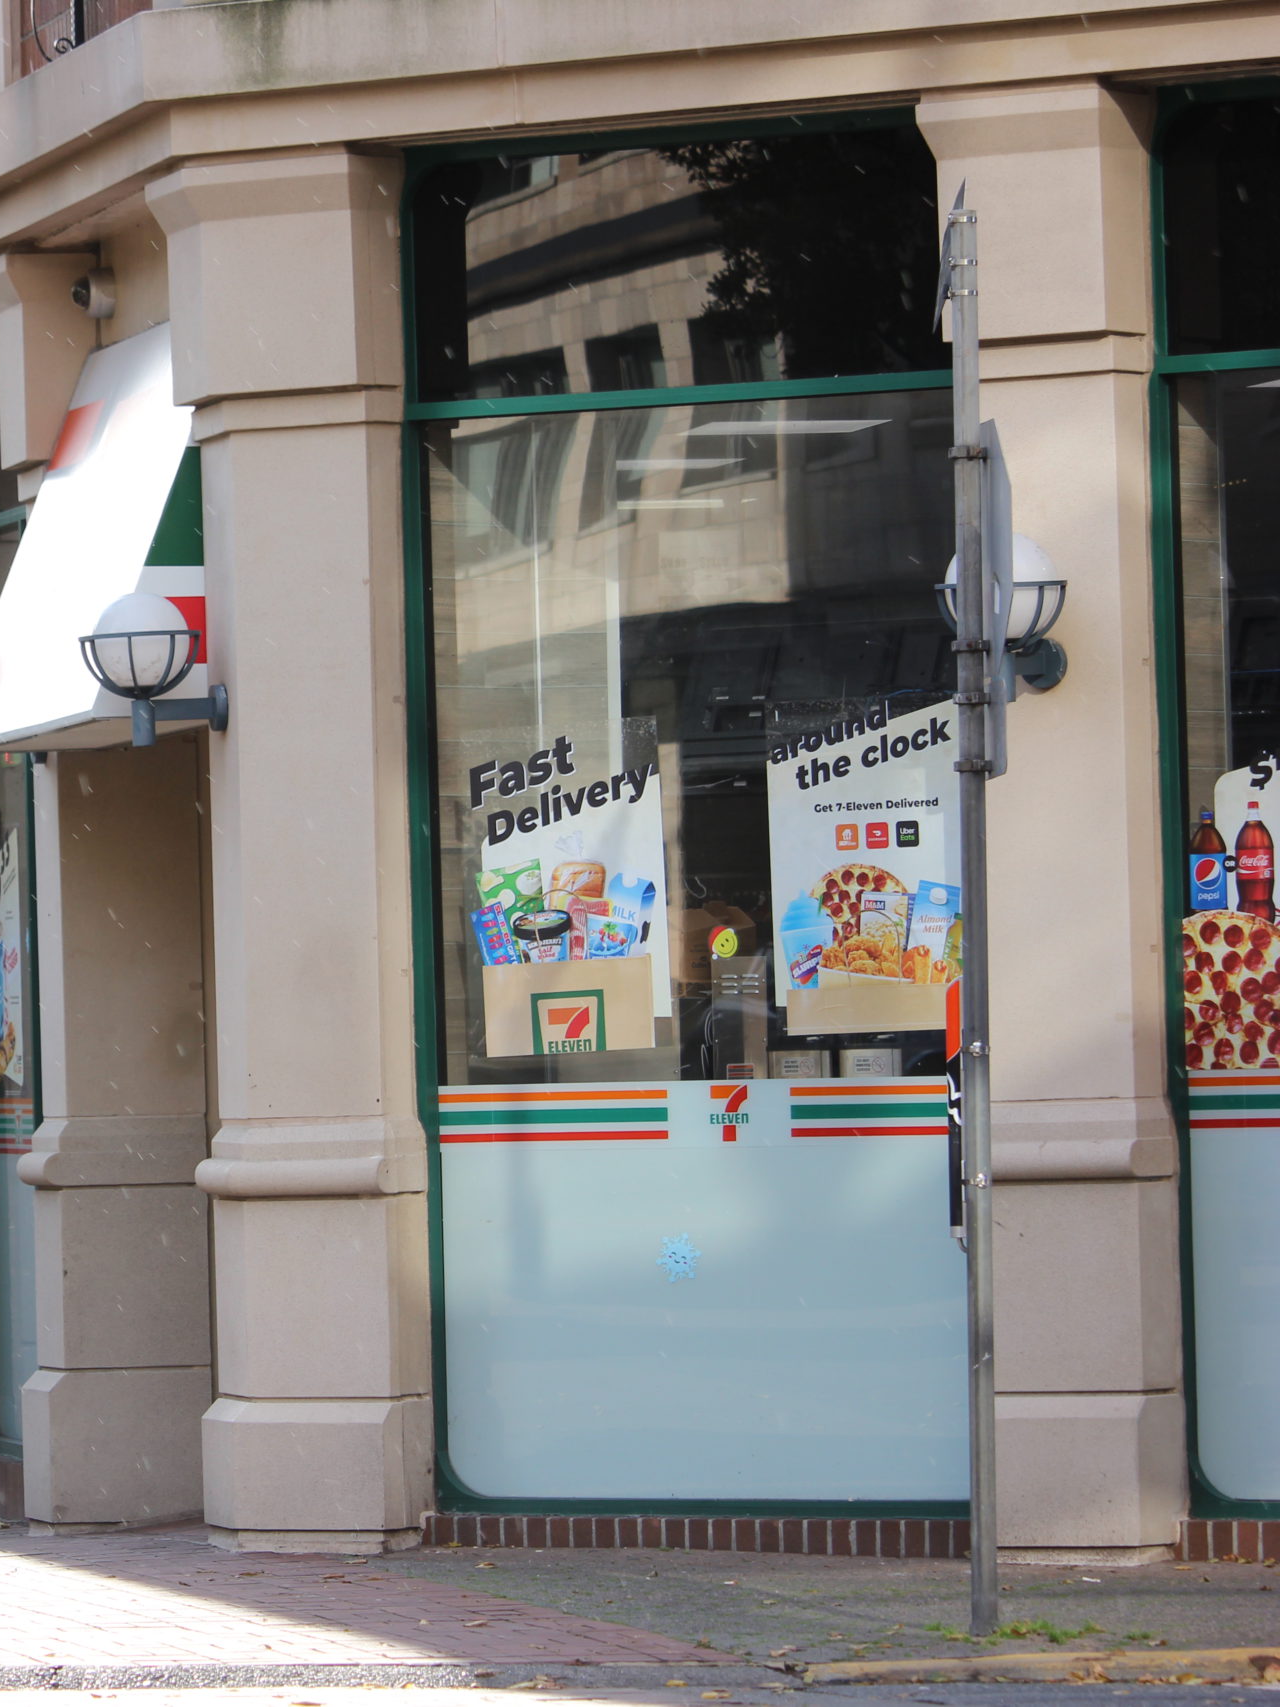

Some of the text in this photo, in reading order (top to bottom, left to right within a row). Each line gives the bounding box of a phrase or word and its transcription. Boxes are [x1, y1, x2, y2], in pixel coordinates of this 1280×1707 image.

[770, 700, 888, 765] around
[795, 717, 953, 791] the clock
[469, 736, 575, 809] Fast
[487, 763, 653, 847] Delivery
[814, 797, 939, 813] Get 7-Eleven Delivered
[899, 827, 916, 835] Uber
[1197, 890, 1220, 901] pepsi
[917, 914, 954, 924] Almond
[923, 925, 945, 934] Milk
